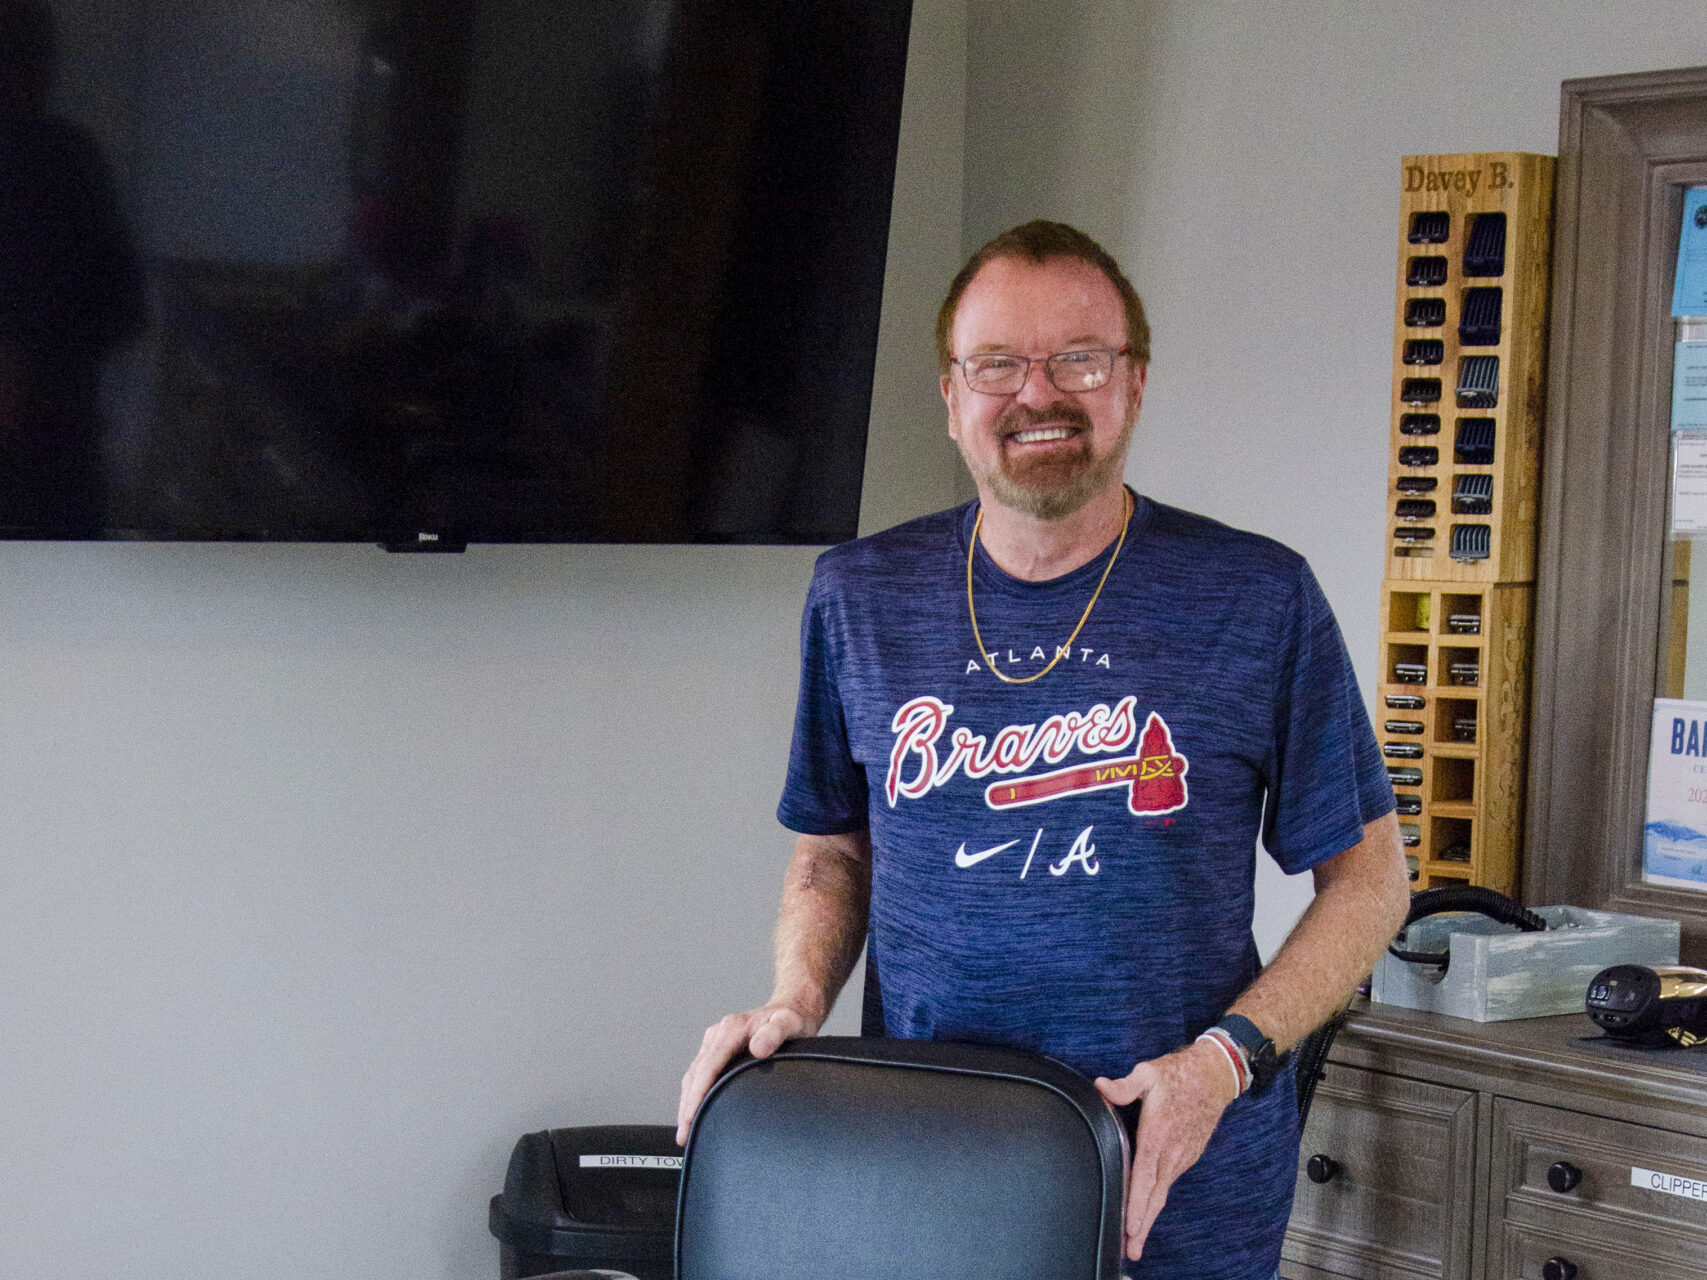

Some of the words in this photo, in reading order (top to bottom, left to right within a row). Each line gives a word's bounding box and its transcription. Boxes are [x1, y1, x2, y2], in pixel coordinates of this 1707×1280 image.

[1405, 165, 1482, 198] Davey
[1487, 161, 1514, 190] B.
[965, 645, 1111, 674] ATLANTA
[886, 695, 1138, 808] Braves
[600, 1156, 647, 1165] DIRTY
